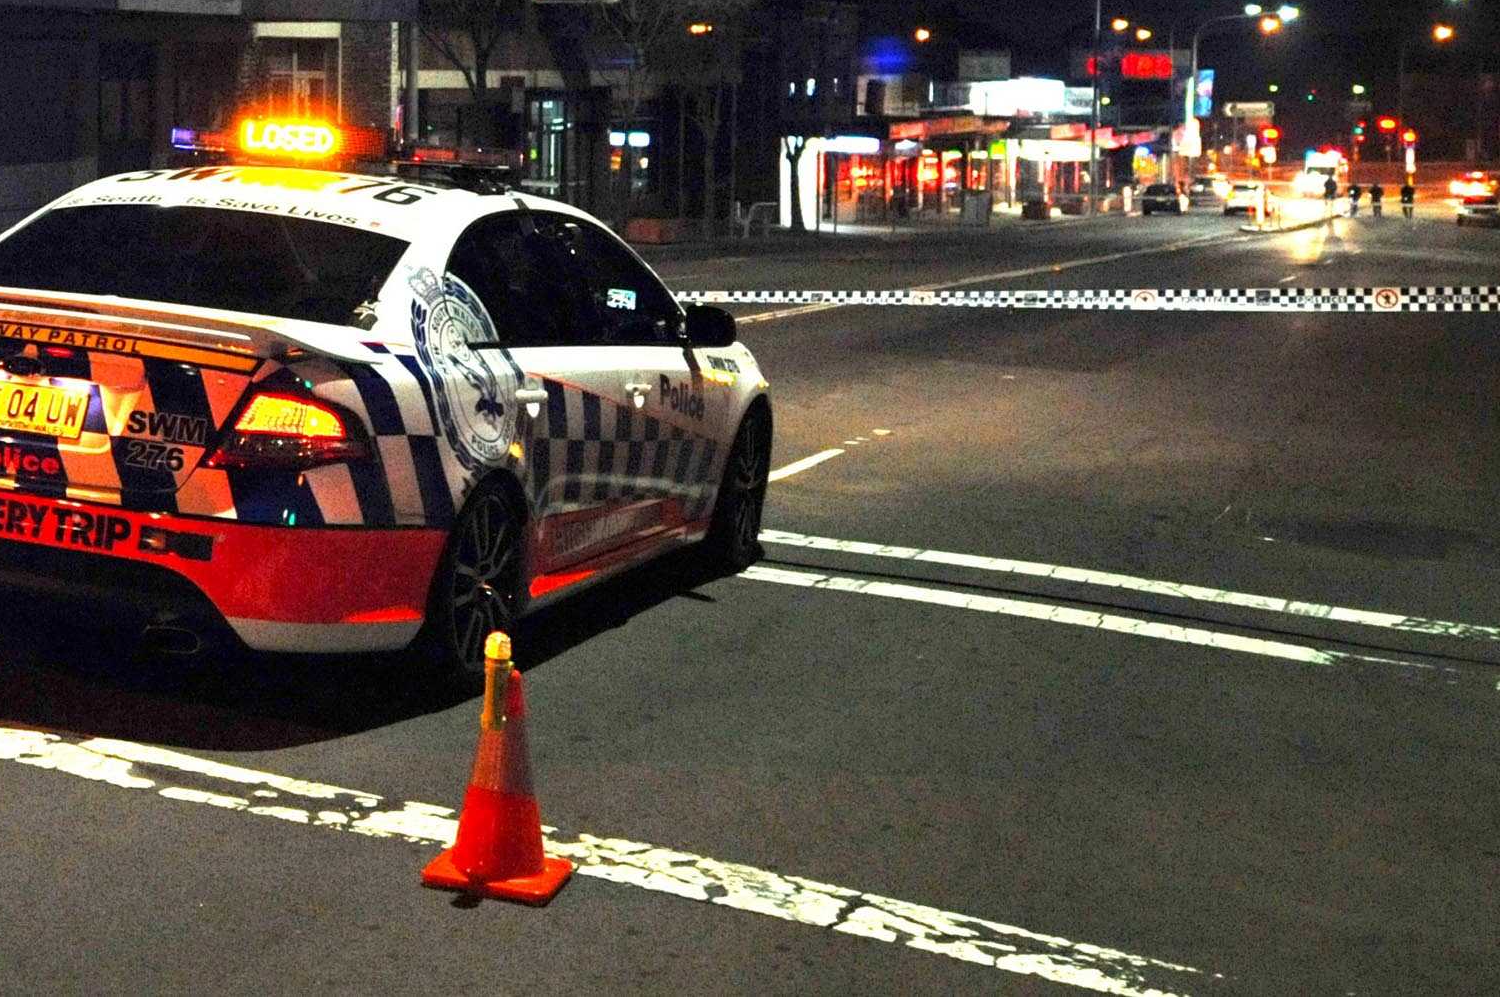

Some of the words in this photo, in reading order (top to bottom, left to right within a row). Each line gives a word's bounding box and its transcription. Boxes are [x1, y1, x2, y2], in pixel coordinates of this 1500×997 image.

[245, 119, 335, 154] LOSED
[214, 196, 280, 211] Save
[287, 205, 358, 226] Lives
[48, 330, 143, 356] PATROL
[7, 389, 39, 421] 04
[659, 373, 706, 419] Police
[126, 410, 209, 446] SWM
[125, 440, 186, 474] 276
[53, 507, 133, 552] TRIP
